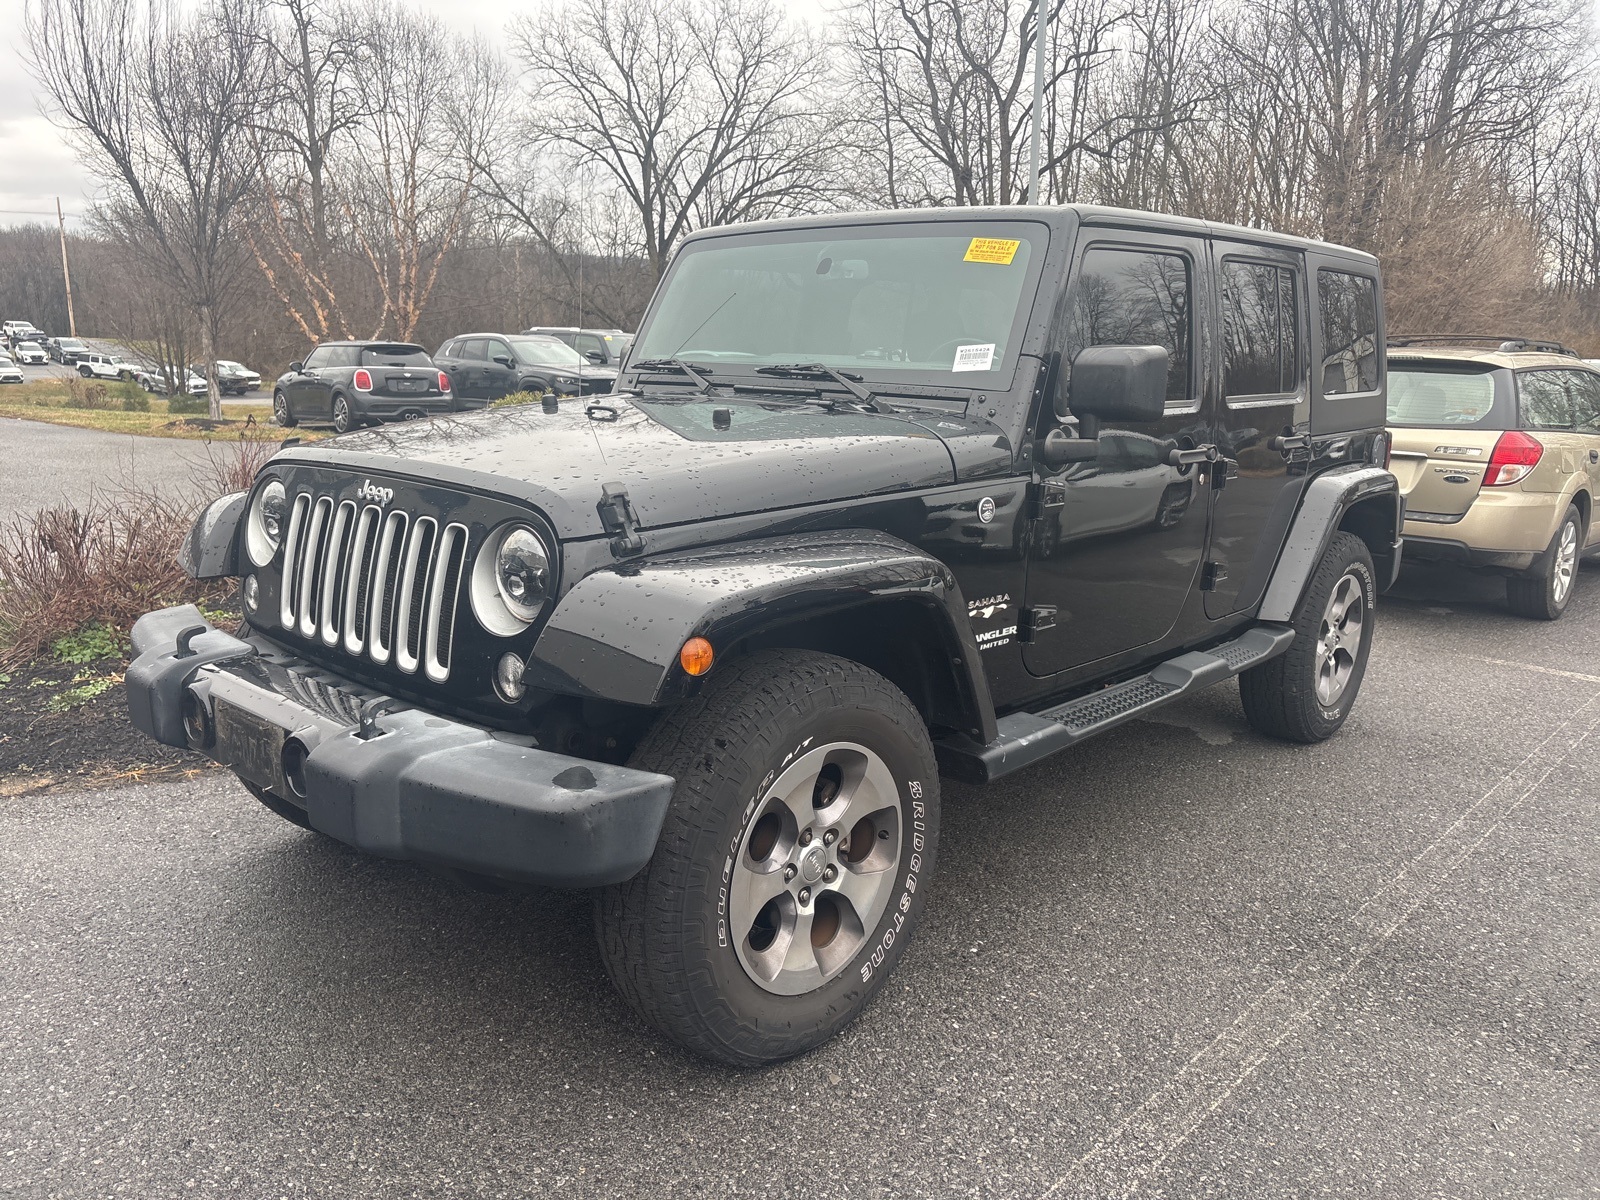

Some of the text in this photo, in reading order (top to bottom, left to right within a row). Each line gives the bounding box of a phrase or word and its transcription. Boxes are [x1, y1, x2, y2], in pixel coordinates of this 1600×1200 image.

[357, 479, 393, 508] Jeep
[968, 593, 1011, 609] SAHARA
[860, 780, 926, 983] BRIDGESTONE
